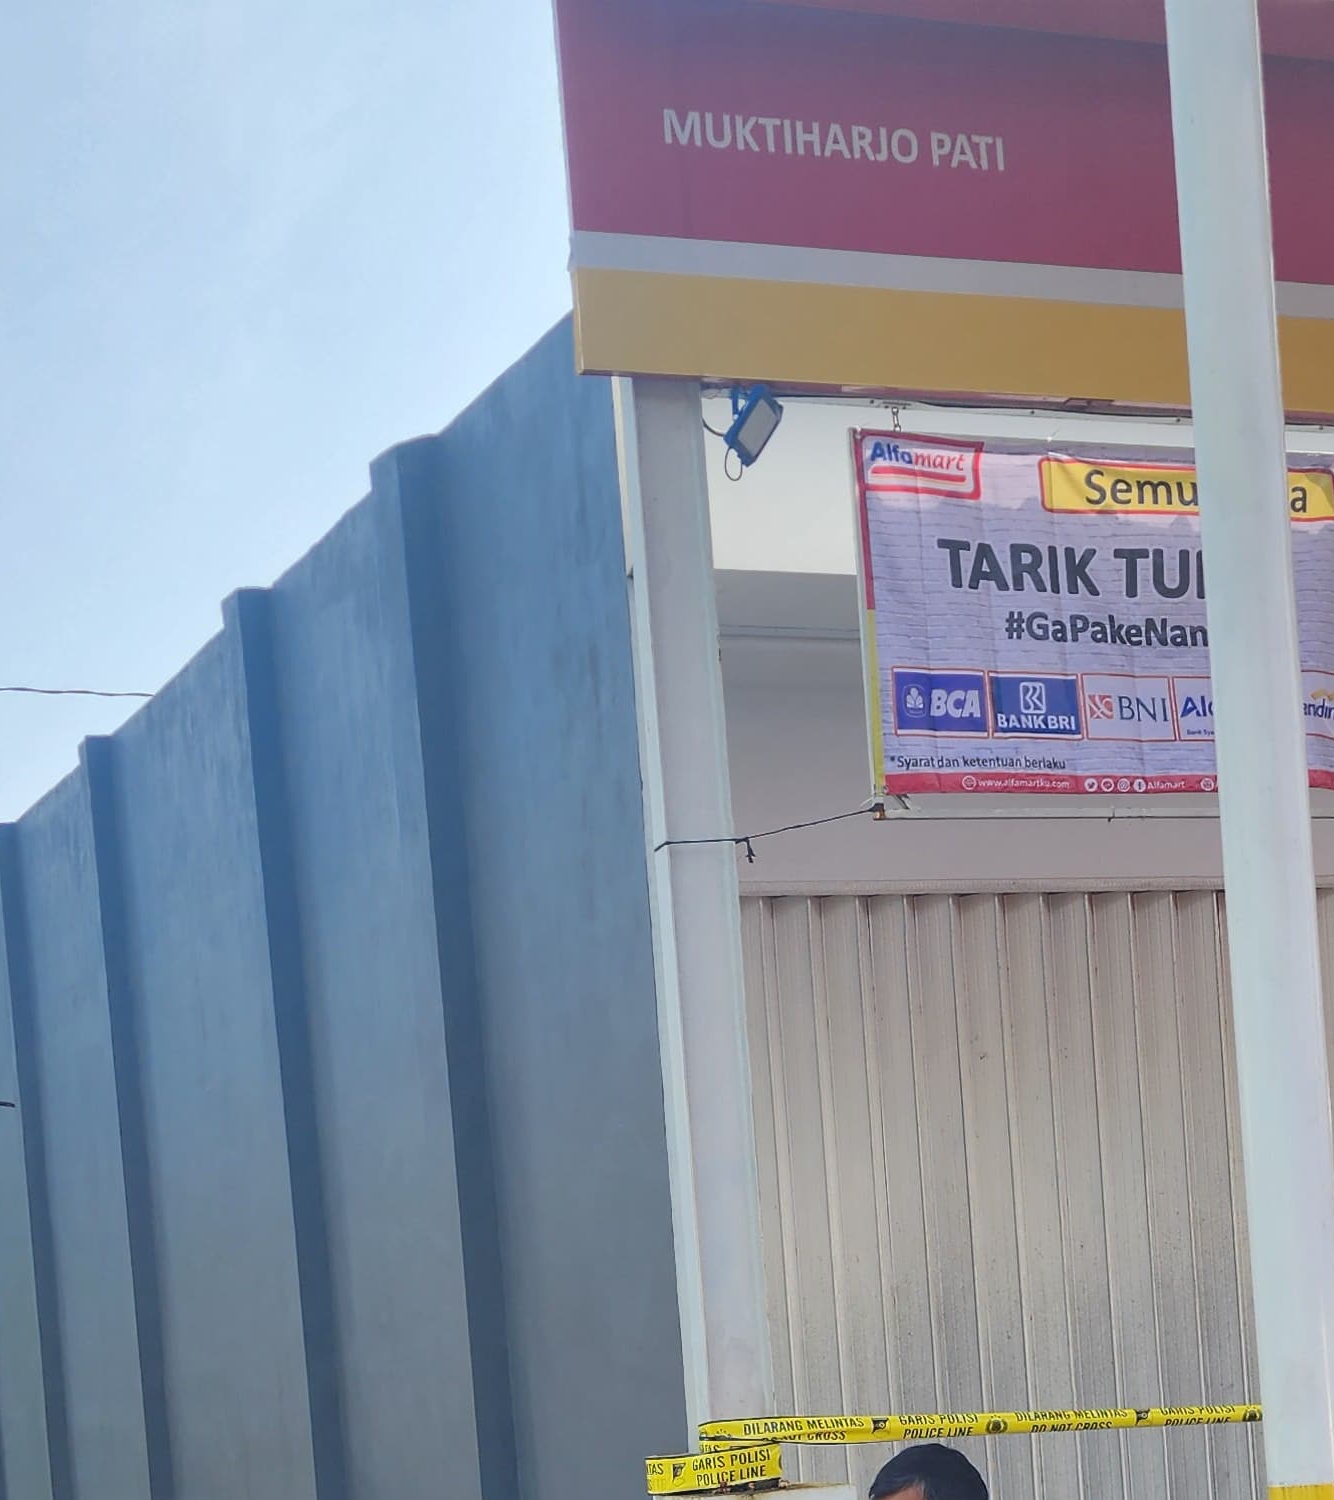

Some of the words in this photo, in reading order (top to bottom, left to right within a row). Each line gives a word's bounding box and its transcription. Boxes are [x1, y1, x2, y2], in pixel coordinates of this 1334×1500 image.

[663, 108, 918, 165] MUKTIHARJO
[931, 131, 1006, 172] PATI
[870, 440, 965, 472] Alfamart
[1085, 469, 1199, 507] Semu
[937, 538, 1101, 597] TARIK
[1005, 611, 1210, 648] #GaPakeNan
[929, 689, 982, 719] BCA
[1117, 695, 1170, 722] BNI
[997, 713, 1046, 730] BANK
[1047, 715, 1077, 731] BRI
[937, 755, 960, 769] dan
[962, 755, 1022, 769] ketentuan
[1024, 755, 1067, 770] berlaku
[978, 778, 1070, 790] www.alfamartku.com
[1147, 780, 1186, 790] Alfamart
[743, 1420, 804, 1436] DILARANG
[807, 1418, 865, 1430] MELINTAS
[898, 1414, 936, 1426] GARIS
[939, 1413, 979, 1425] POLISI
[903, 1428, 944, 1439] POLICE
[947, 1426, 974, 1438] LINE
[692, 1455, 726, 1471] GARIS
[730, 1448, 771, 1467] POLISI
[696, 1470, 736, 1487] POLICE
[740, 1464, 767, 1480] LINE
